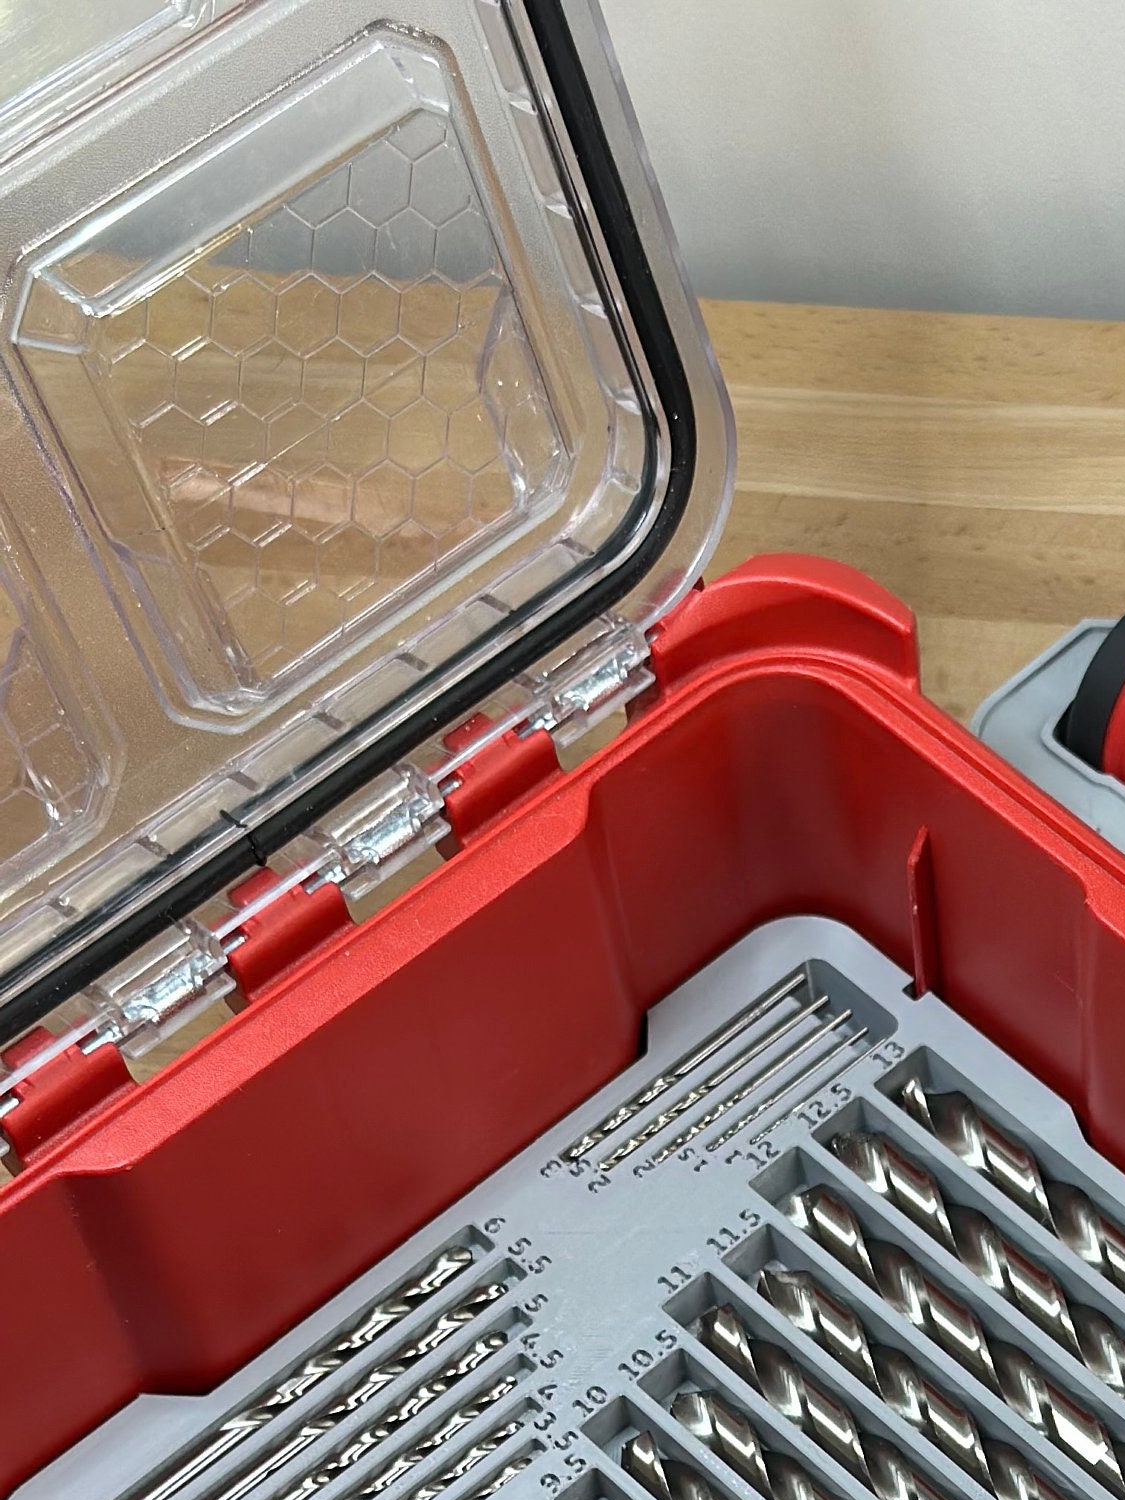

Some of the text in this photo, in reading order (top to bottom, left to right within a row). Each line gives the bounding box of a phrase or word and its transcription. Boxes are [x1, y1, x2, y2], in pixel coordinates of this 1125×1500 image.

[871, 1041, 905, 1069] 13
[797, 1082, 852, 1129] 12.5
[540, 1160, 562, 1178] 3
[633, 1160, 656, 1178] 2
[746, 1140, 782, 1170] 12
[484, 1218, 506, 1234] 6
[706, 1208, 760, 1254] 11.5
[508, 1238, 552, 1274] 5.5
[658, 1266, 692, 1294] 11
[524, 1294, 548, 1312] 5
[618, 1330, 678, 1380] 10.5
[573, 1386, 607, 1417] 10
[540, 1453, 587, 1494] 9.5
